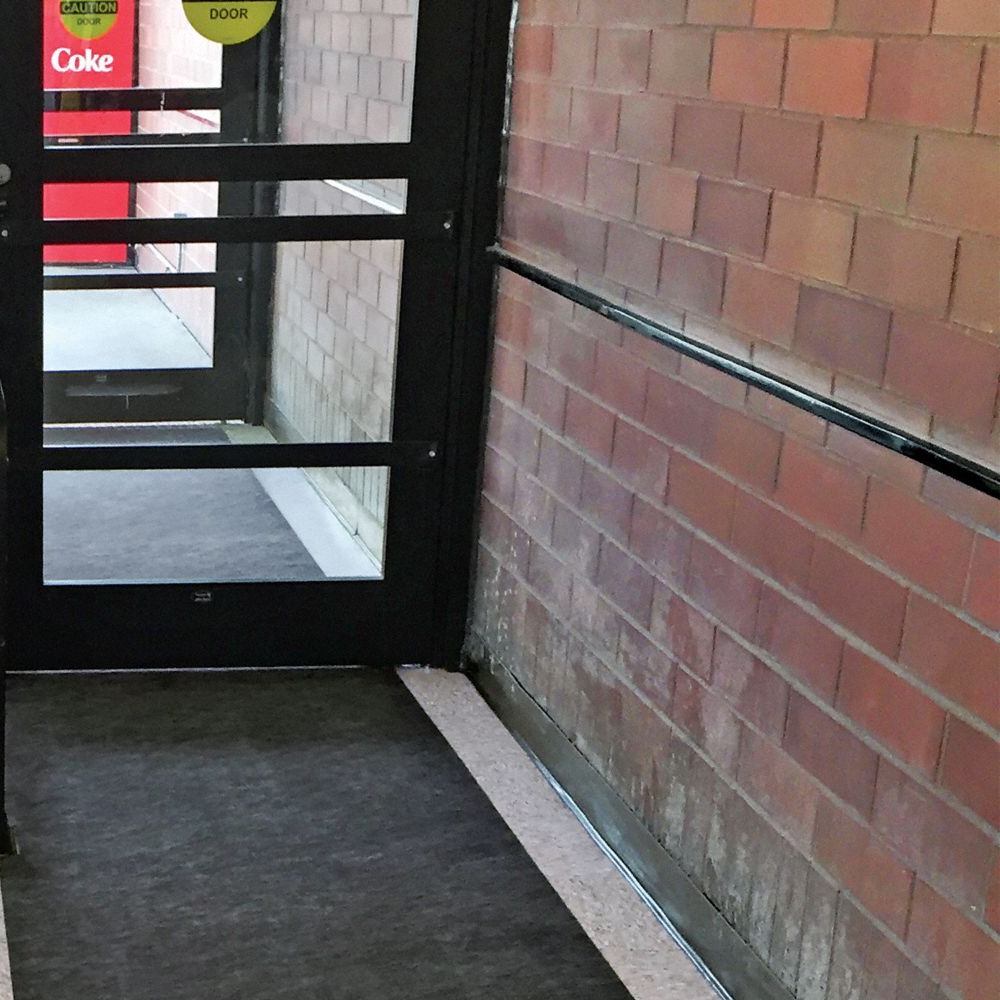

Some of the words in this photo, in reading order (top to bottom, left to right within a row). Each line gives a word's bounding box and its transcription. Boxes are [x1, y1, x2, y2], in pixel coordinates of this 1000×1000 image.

[62, 2, 116, 13] CAUTION
[210, 8, 248, 19] DOOR
[77, 17, 101, 25] DOOR
[51, 47, 114, 72] Coke
